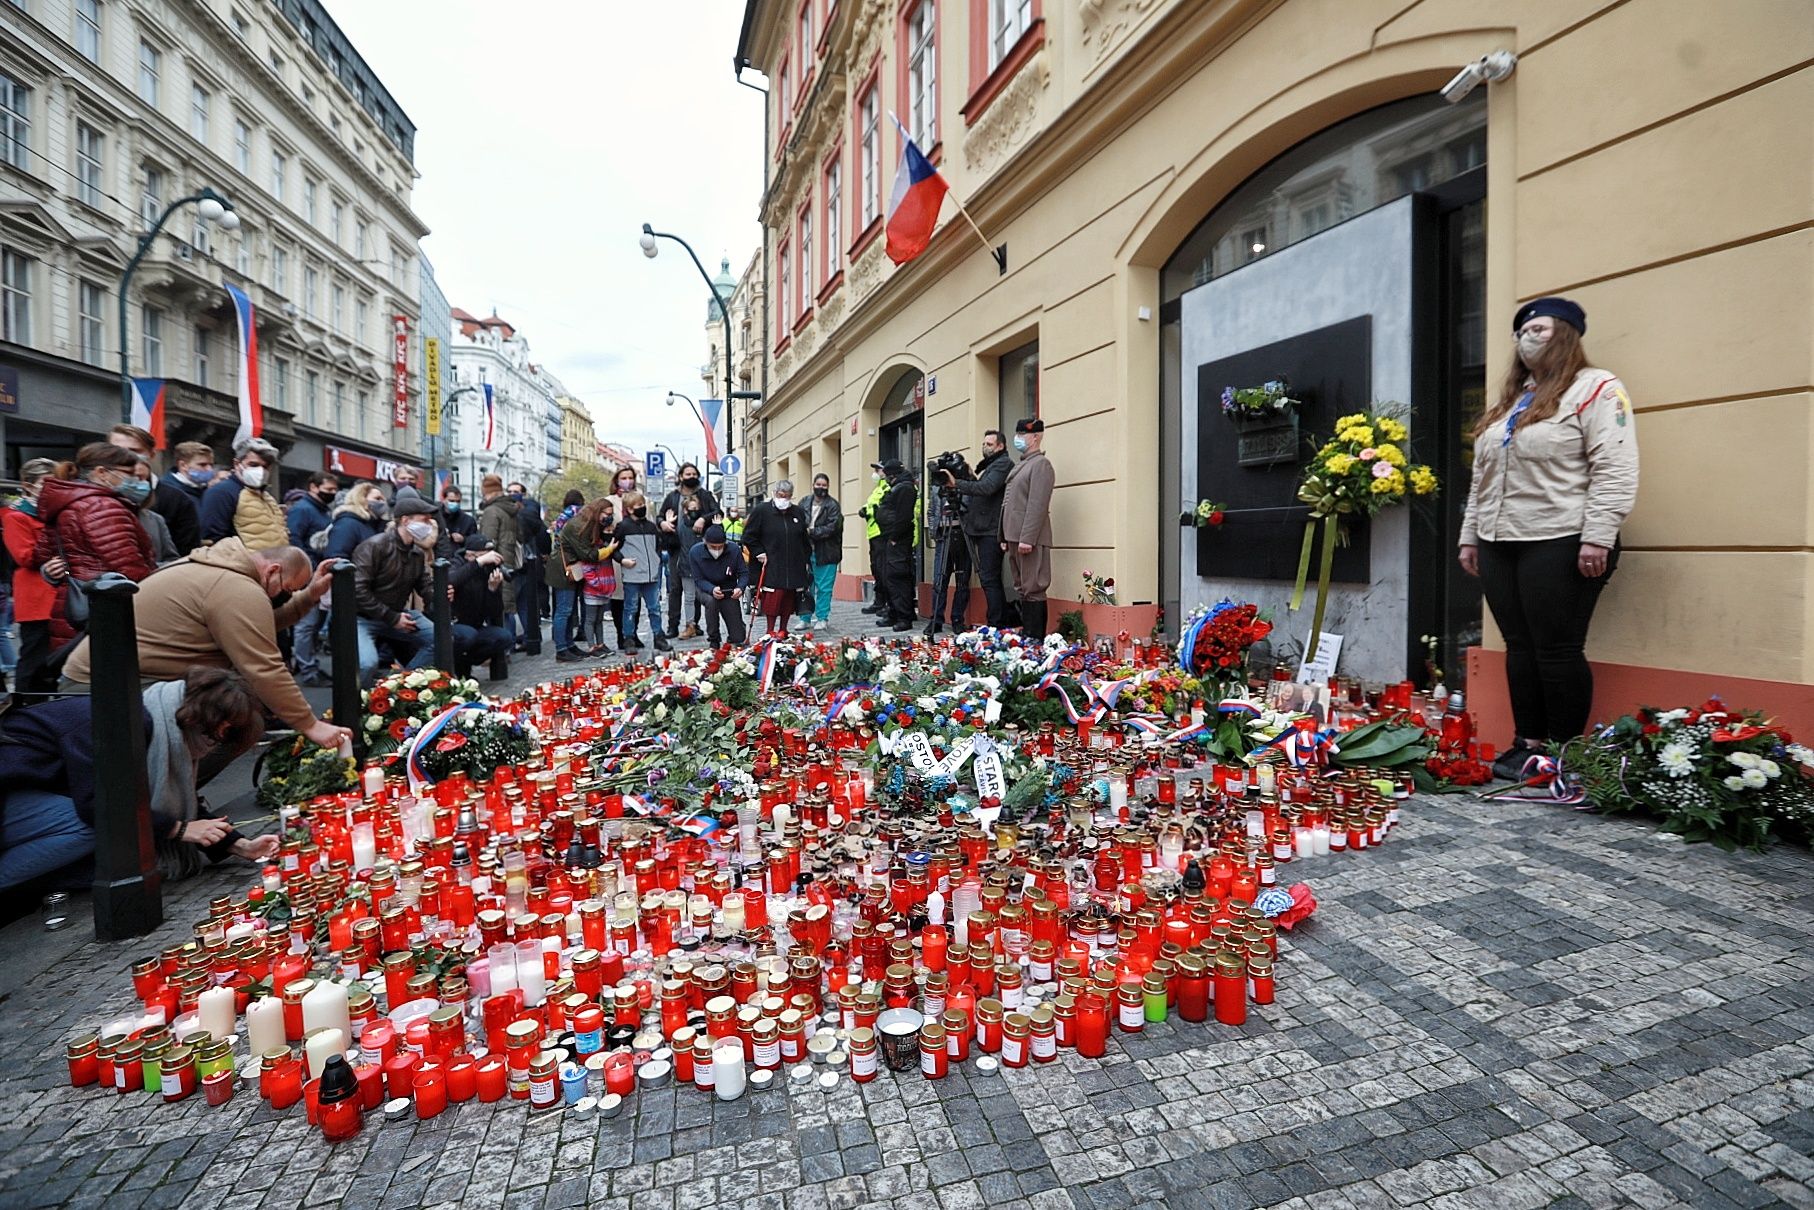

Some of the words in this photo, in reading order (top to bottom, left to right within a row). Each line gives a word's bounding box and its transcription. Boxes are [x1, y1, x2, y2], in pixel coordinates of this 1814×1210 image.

[396, 340, 406, 364] KFC
[428, 341, 437, 386] DIVADLO
[397, 371, 406, 394] KFC
[396, 400, 407, 423] KFC
[429, 389, 438, 421] METRO
[649, 454, 661, 470] P
